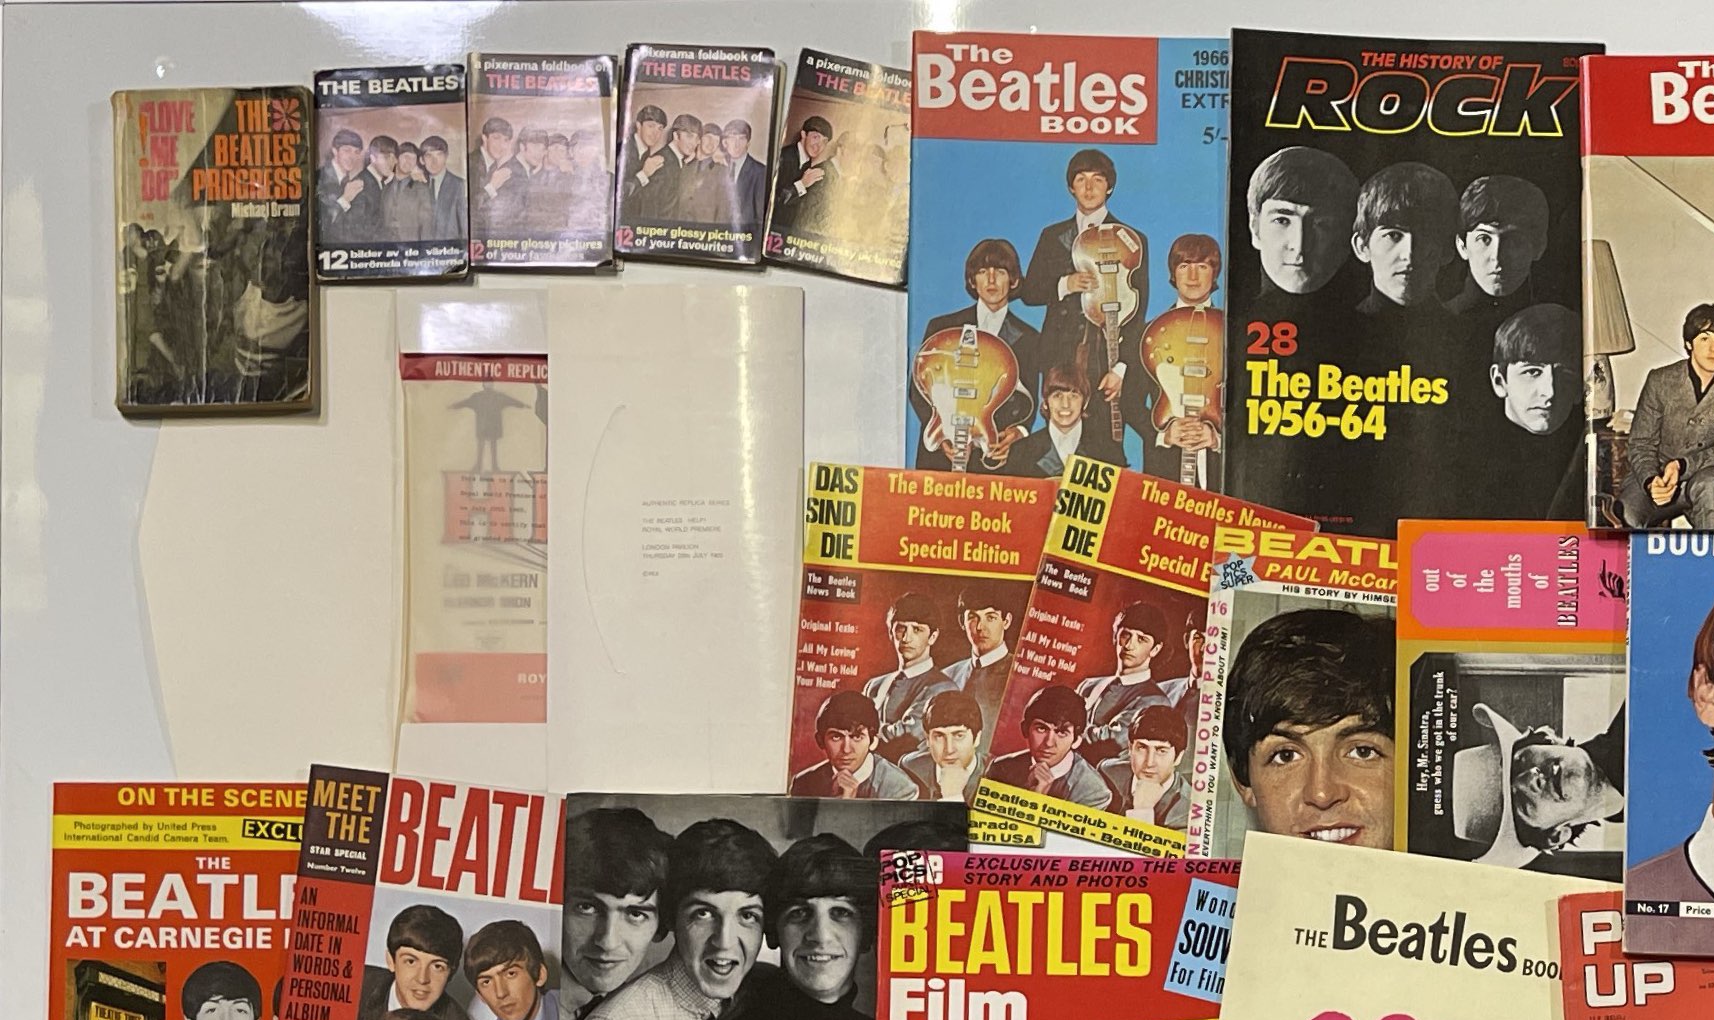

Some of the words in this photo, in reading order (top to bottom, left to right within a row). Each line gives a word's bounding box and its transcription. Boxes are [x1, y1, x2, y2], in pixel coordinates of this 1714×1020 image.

[1362, 52, 1396, 67] THE
[1399, 53, 1473, 69] HISTORY
[1480, 56, 1503, 69] OF
[319, 81, 360, 96] THE
[368, 76, 459, 94] BEATLES
[1265, 57, 1580, 136] ROCK
[235, 101, 271, 133] THE
[215, 134, 297, 167] BEATLES'
[192, 168, 301, 201] PROGRESS
[231, 202, 269, 218] Michael
[271, 203, 300, 218] Braun
[636, 226, 668, 240] super
[671, 227, 706, 243] glossy
[708, 229, 752, 244] pictures
[1247, 322, 1298, 355] 28
[435, 361, 501, 378] AUTHENTIC
[1247, 360, 1311, 398] The
[1320, 364, 1448, 404] Beatles
[1247, 399, 1386, 440] 1956-64
[889, 473, 917, 497] The
[923, 474, 984, 502] Beatles
[990, 476, 1037, 505] News
[907, 507, 963, 531] Picture
[970, 510, 1012, 535] Book
[898, 537, 957, 562] Special
[963, 540, 1019, 566] Edition
[1264, 562, 1323, 583] PAUL
[1423, 568, 1440, 593] out
[1446, 572, 1467, 589] of
[1473, 569, 1494, 593] the
[1500, 554, 1522, 609] mouths
[1528, 573, 1549, 589] of
[1557, 535, 1579, 628] BEATLES
[1305, 587, 1340, 599] STORY
[1434, 672, 1444, 700] trunk
[1193, 693, 1216, 790] COLOUR
[73, 821, 139, 833] Photographed
[157, 822, 187, 832] United
[190, 823, 216, 833] Press
[1034, 801, 1106, 828] fan-club
[64, 832, 122, 843] International
[163, 834, 198, 845] Camera
[997, 832, 1036, 845] USA
[1202, 799, 1214, 857] EVERYTHING
[310, 845, 330, 856] STAR
[335, 848, 366, 860] SPECIAL
[964, 857, 1059, 873] EXCLUSIVE
[1068, 859, 1134, 874] BEHIND
[964, 873, 1022, 886] STORY
[1030, 874, 1063, 886] AND
[1072, 875, 1148, 889] PHOTOS
[66, 926, 106, 948] AT
[115, 927, 271, 949] CARNEGIE
[890, 888, 1152, 978] BEATLES
[1332, 894, 1517, 974] Beatles
[290, 978, 351, 1004] PERSONAL
[1584, 961, 1675, 1008] UP
